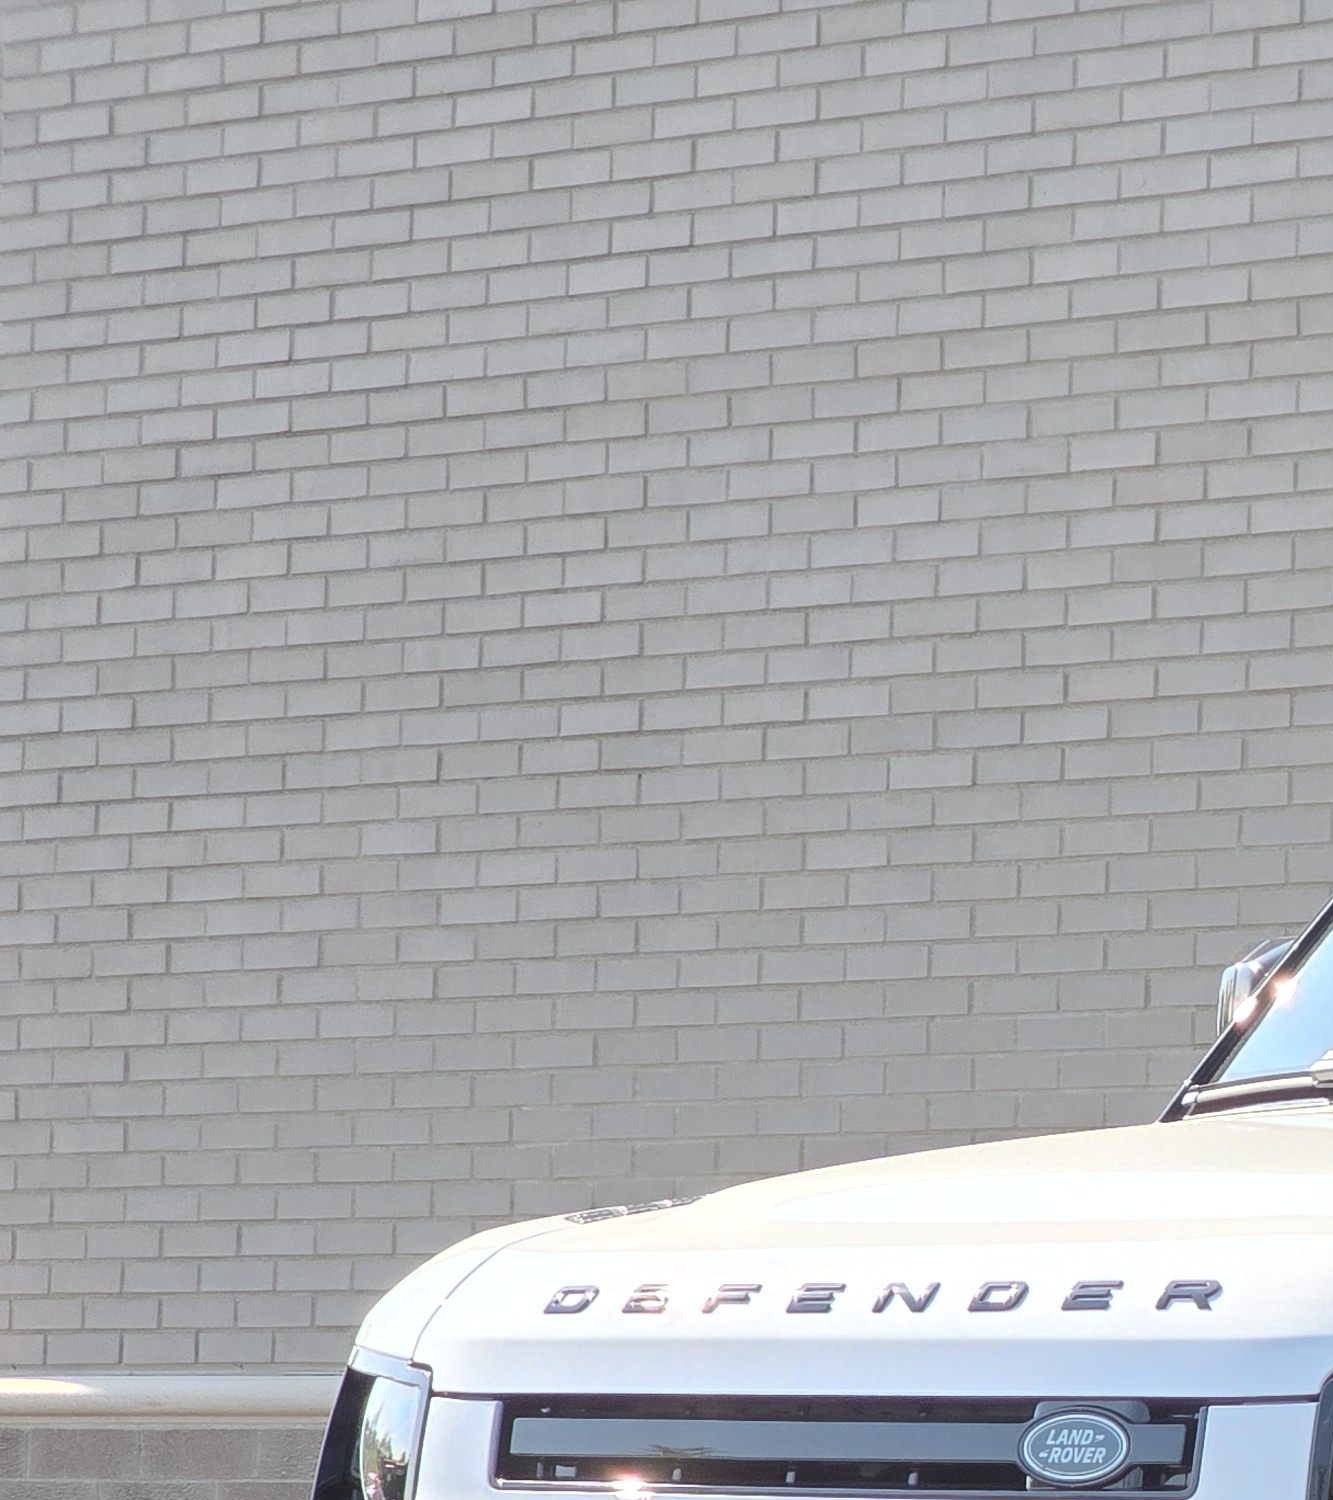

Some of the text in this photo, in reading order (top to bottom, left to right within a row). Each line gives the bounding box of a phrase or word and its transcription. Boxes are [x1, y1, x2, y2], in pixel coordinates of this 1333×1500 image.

[543, 1278, 1224, 1316] DEFENDER
[1046, 1428, 1095, 1446] LAND
[1047, 1446, 1107, 1465] ROVER
